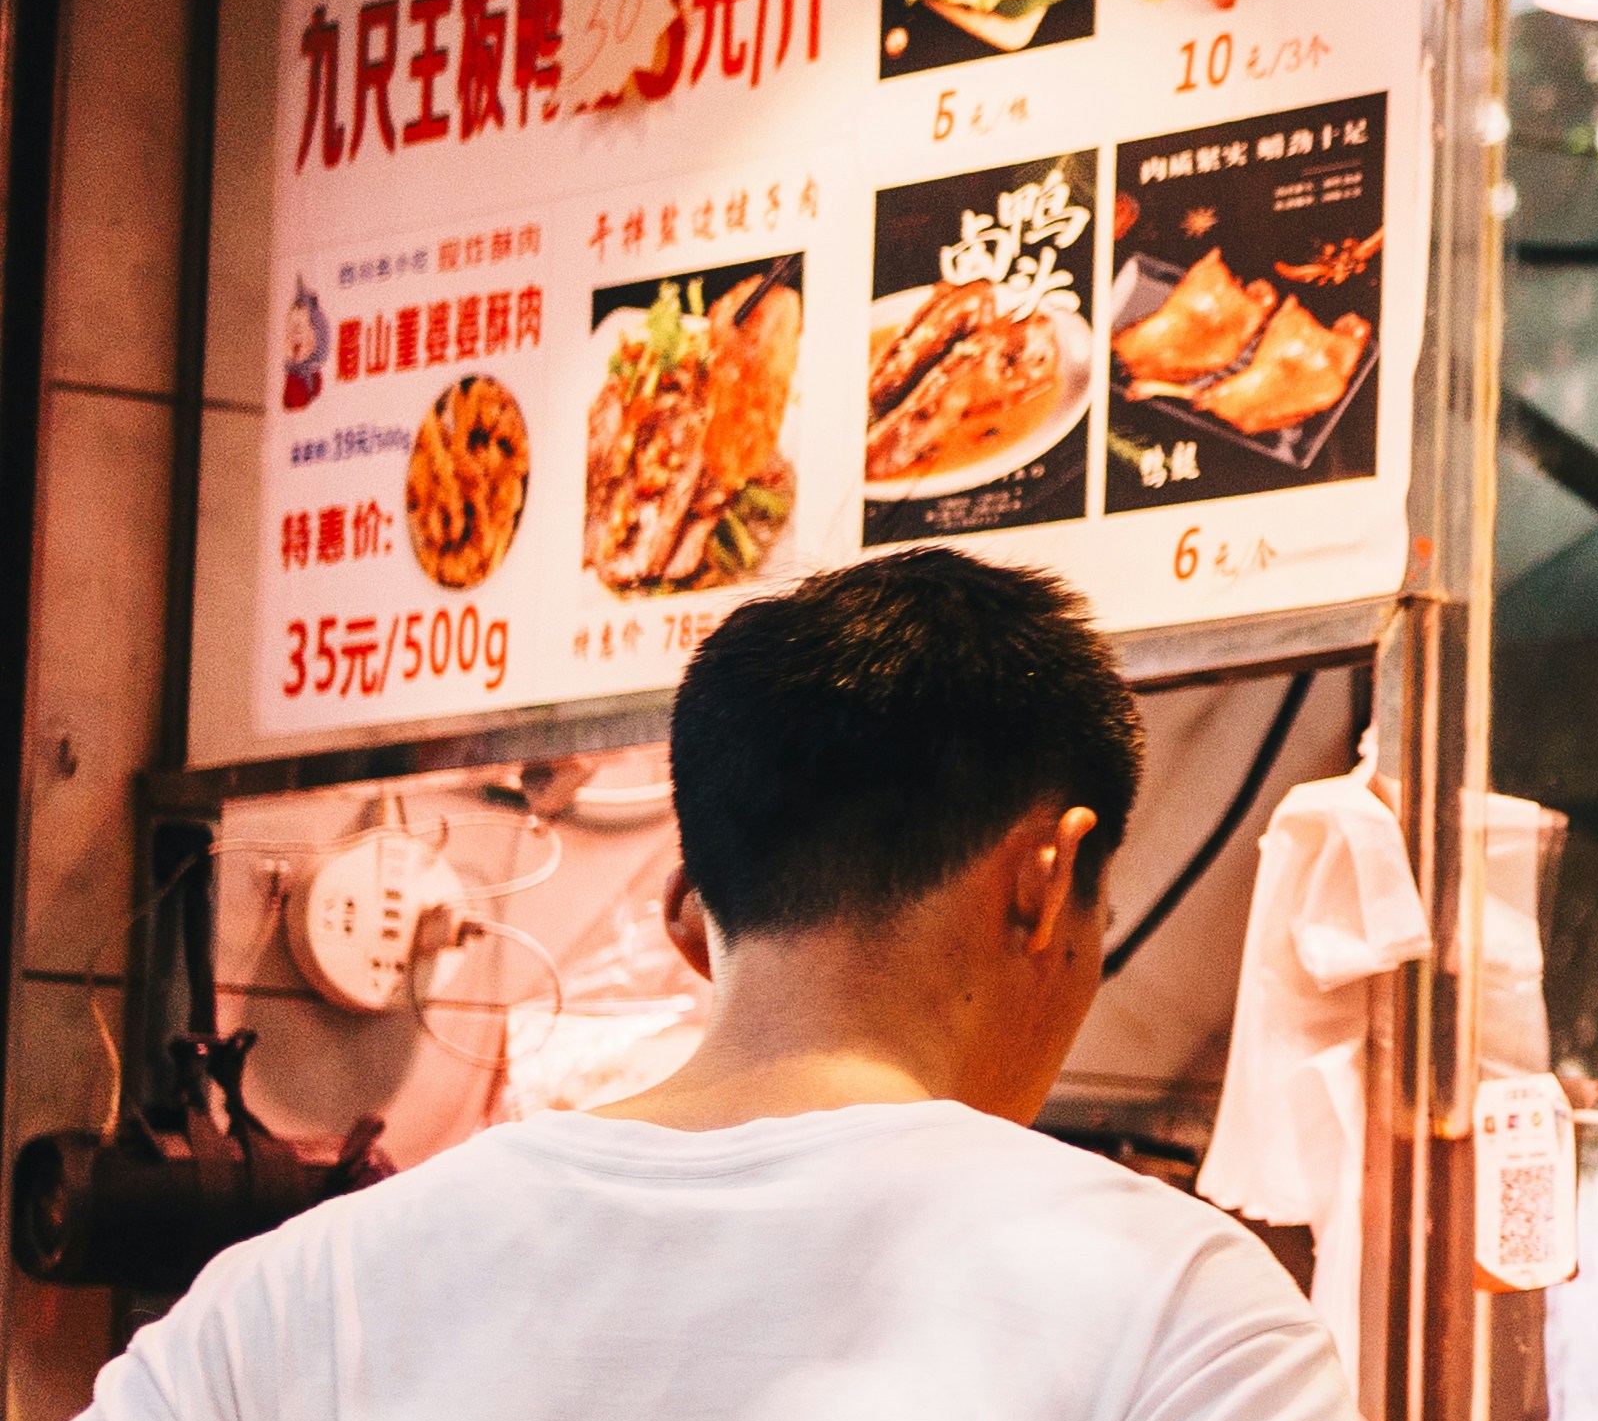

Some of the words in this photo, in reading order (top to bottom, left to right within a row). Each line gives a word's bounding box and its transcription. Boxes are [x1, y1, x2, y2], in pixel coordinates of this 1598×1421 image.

[1175, 33, 1234, 94] 10
[1173, 527, 1200, 581] 6
[282, 604, 509, 699] 35元/500g
